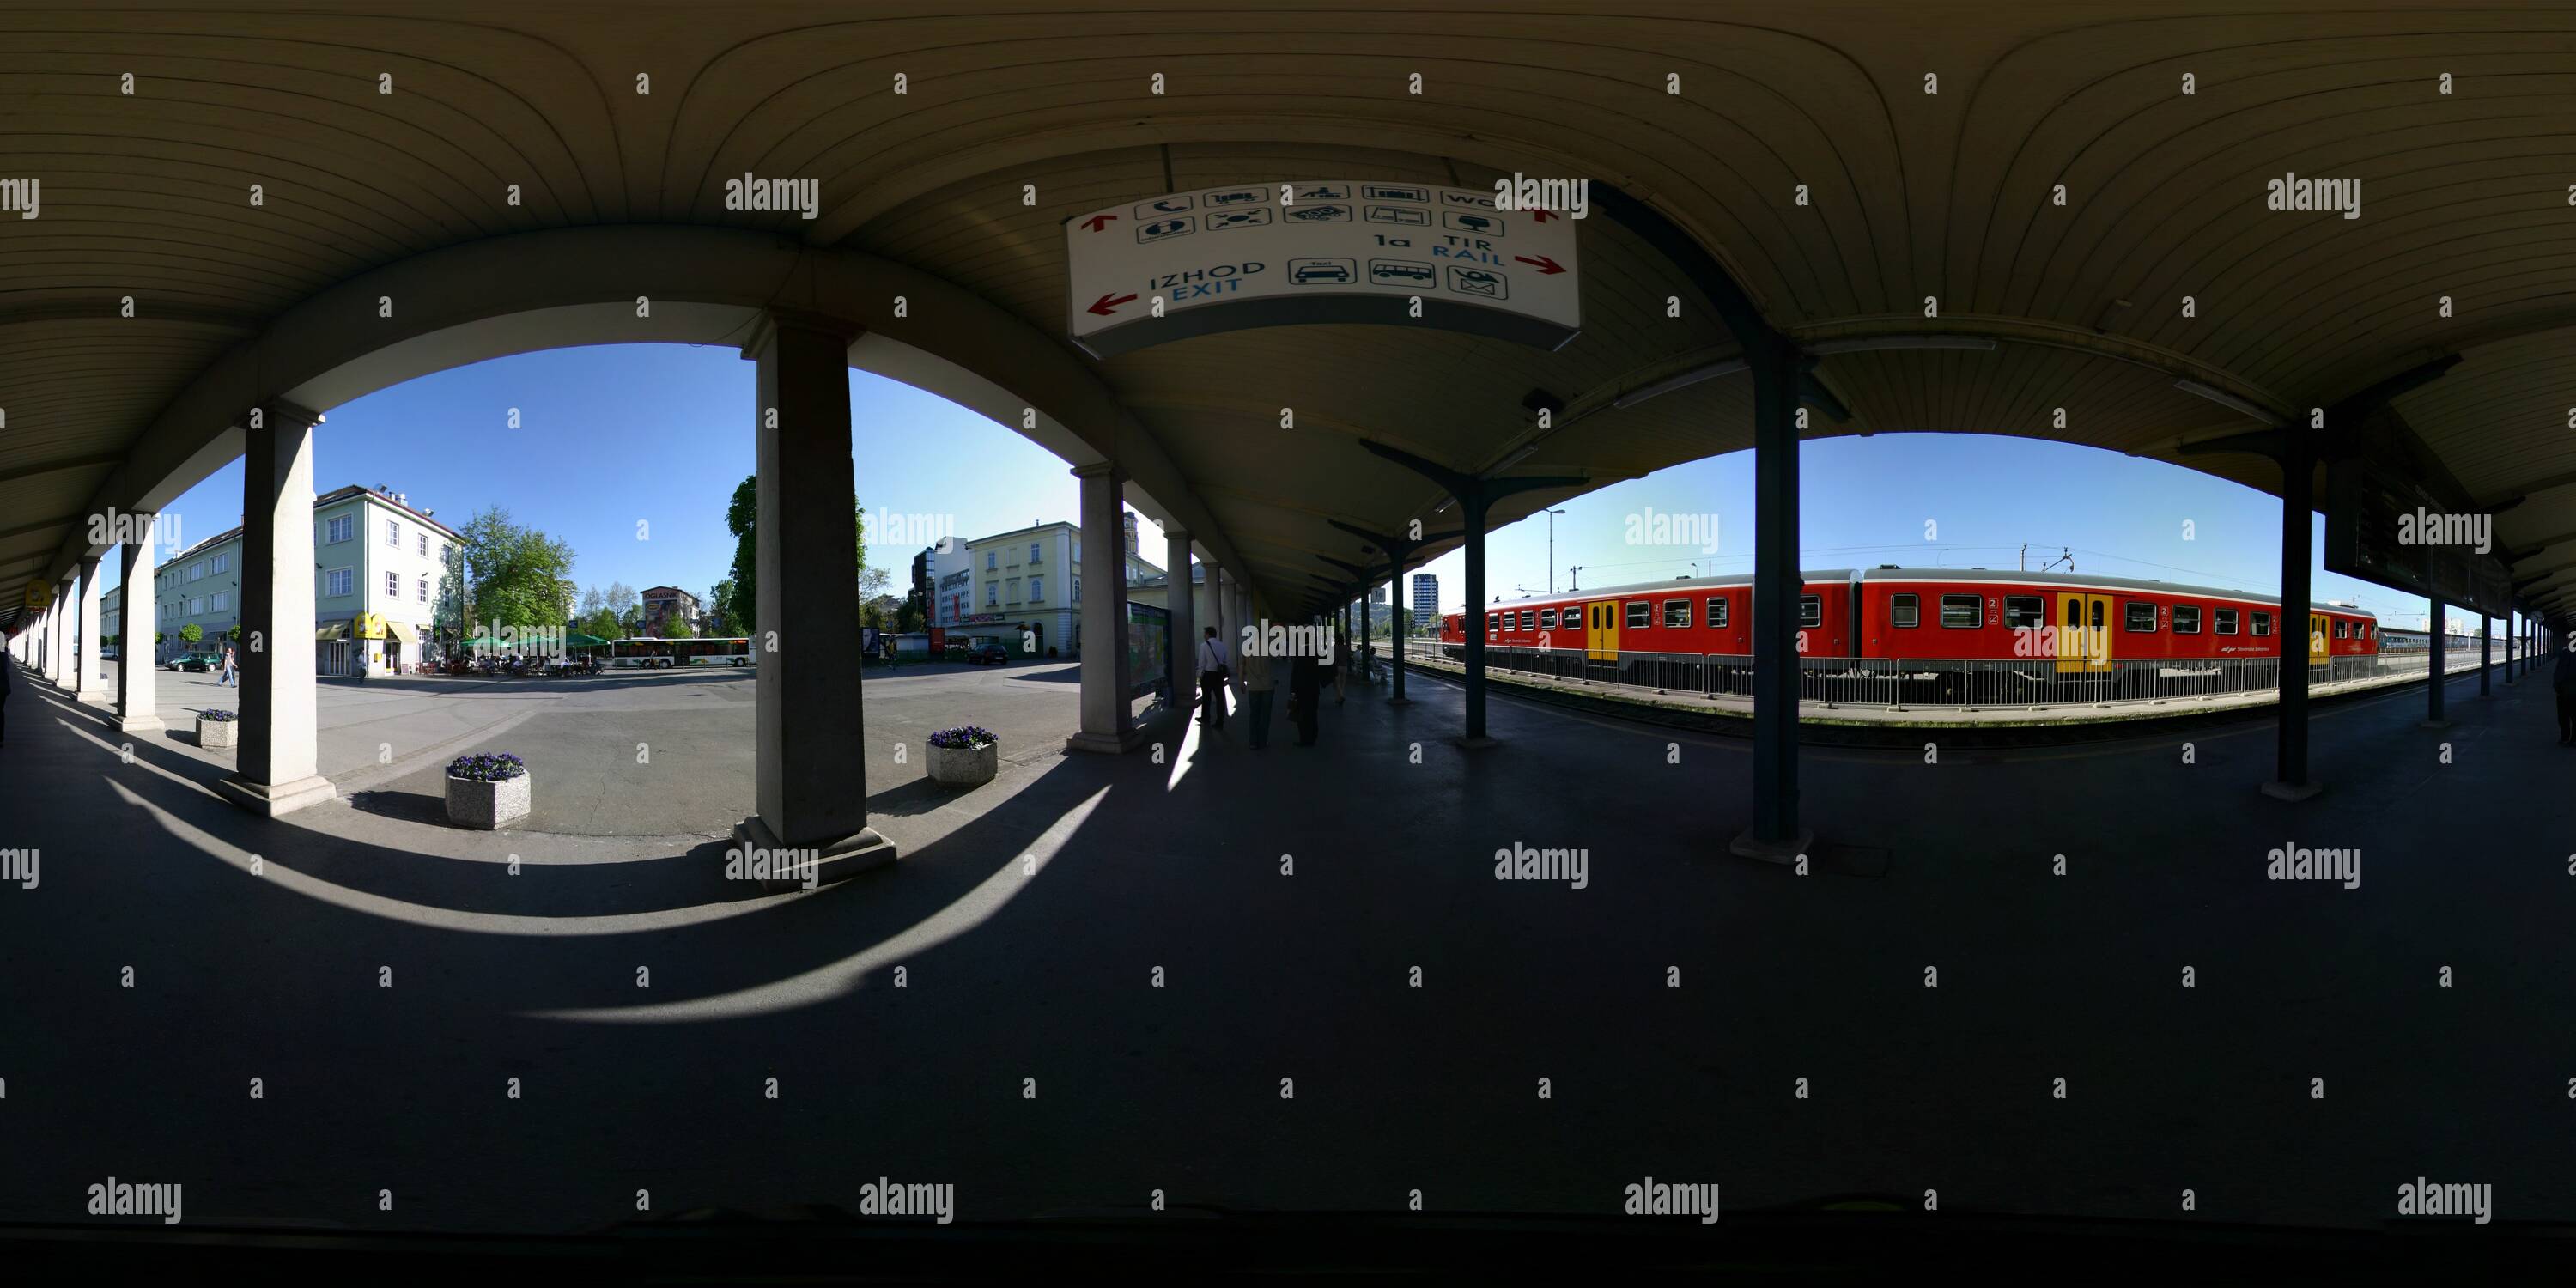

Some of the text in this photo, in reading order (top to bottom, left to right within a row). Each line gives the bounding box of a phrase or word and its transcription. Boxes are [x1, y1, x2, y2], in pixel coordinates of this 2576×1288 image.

[1374, 234, 1411, 247] 1a
[1443, 234, 1492, 252] TIR
[1433, 246, 1505, 267] RAIL
[1150, 262, 1265, 290] IZHOD
[1172, 278, 1242, 301] EXIT
